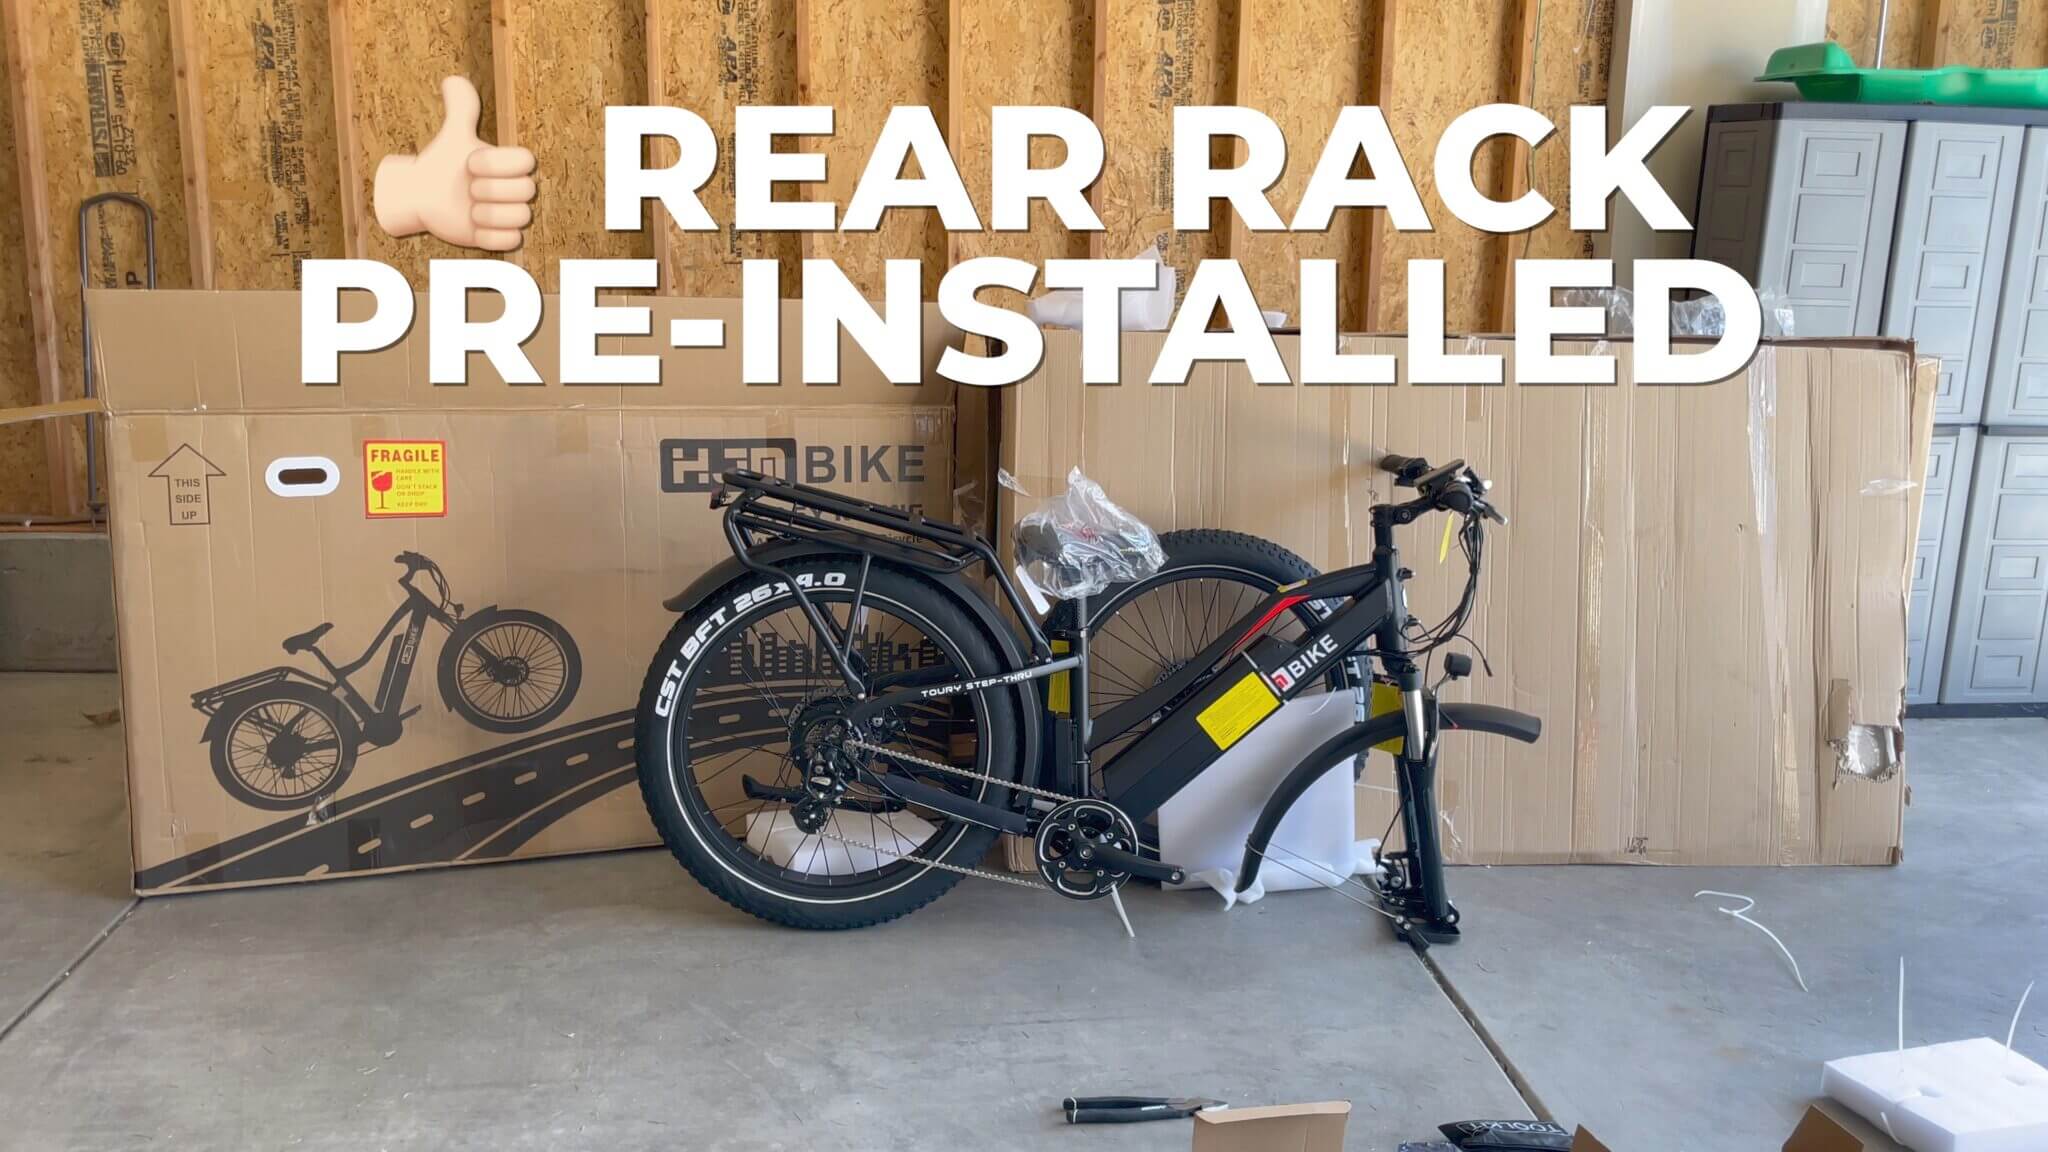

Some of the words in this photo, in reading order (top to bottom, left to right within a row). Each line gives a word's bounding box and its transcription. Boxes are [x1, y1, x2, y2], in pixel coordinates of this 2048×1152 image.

[370, 449, 440, 462] FRAGILE
[805, 445, 925, 484] BIKE
[175, 478, 201, 488] THIS
[175, 494, 201, 504] SIDE
[181, 511, 197, 520] UP
[654, 658, 683, 718] CST
[679, 606, 726, 661] BFT
[1287, 633, 1339, 680] BIKE
[920, 684, 962, 698] TOURY
[965, 671, 1033, 690] STEP-THRU
[1467, 1120, 1562, 1133] TOOLKIT
